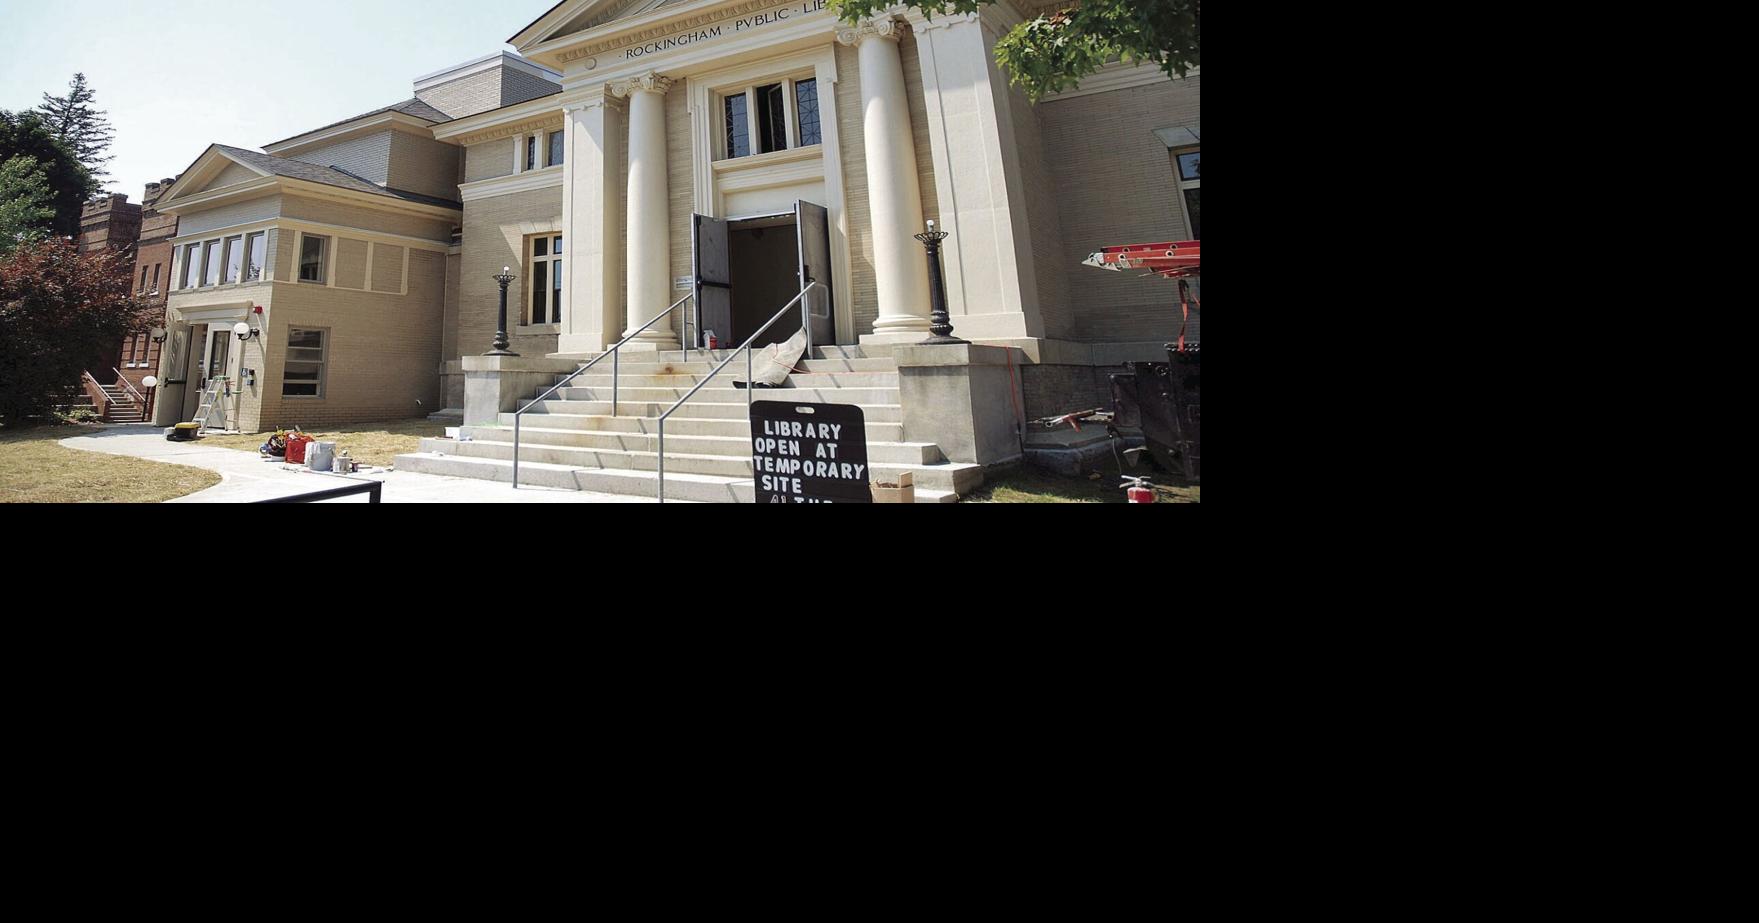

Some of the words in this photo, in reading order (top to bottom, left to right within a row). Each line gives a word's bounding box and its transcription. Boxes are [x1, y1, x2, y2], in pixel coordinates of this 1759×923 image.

[626, 26, 721, 59] ROCKINGHAM
[764, 420, 841, 440] LIBRARY
[755, 437, 800, 456] OPEN
[816, 442, 838, 459] AT
[753, 455, 865, 480] TEMPORARY
[761, 474, 802, 494] SITE
